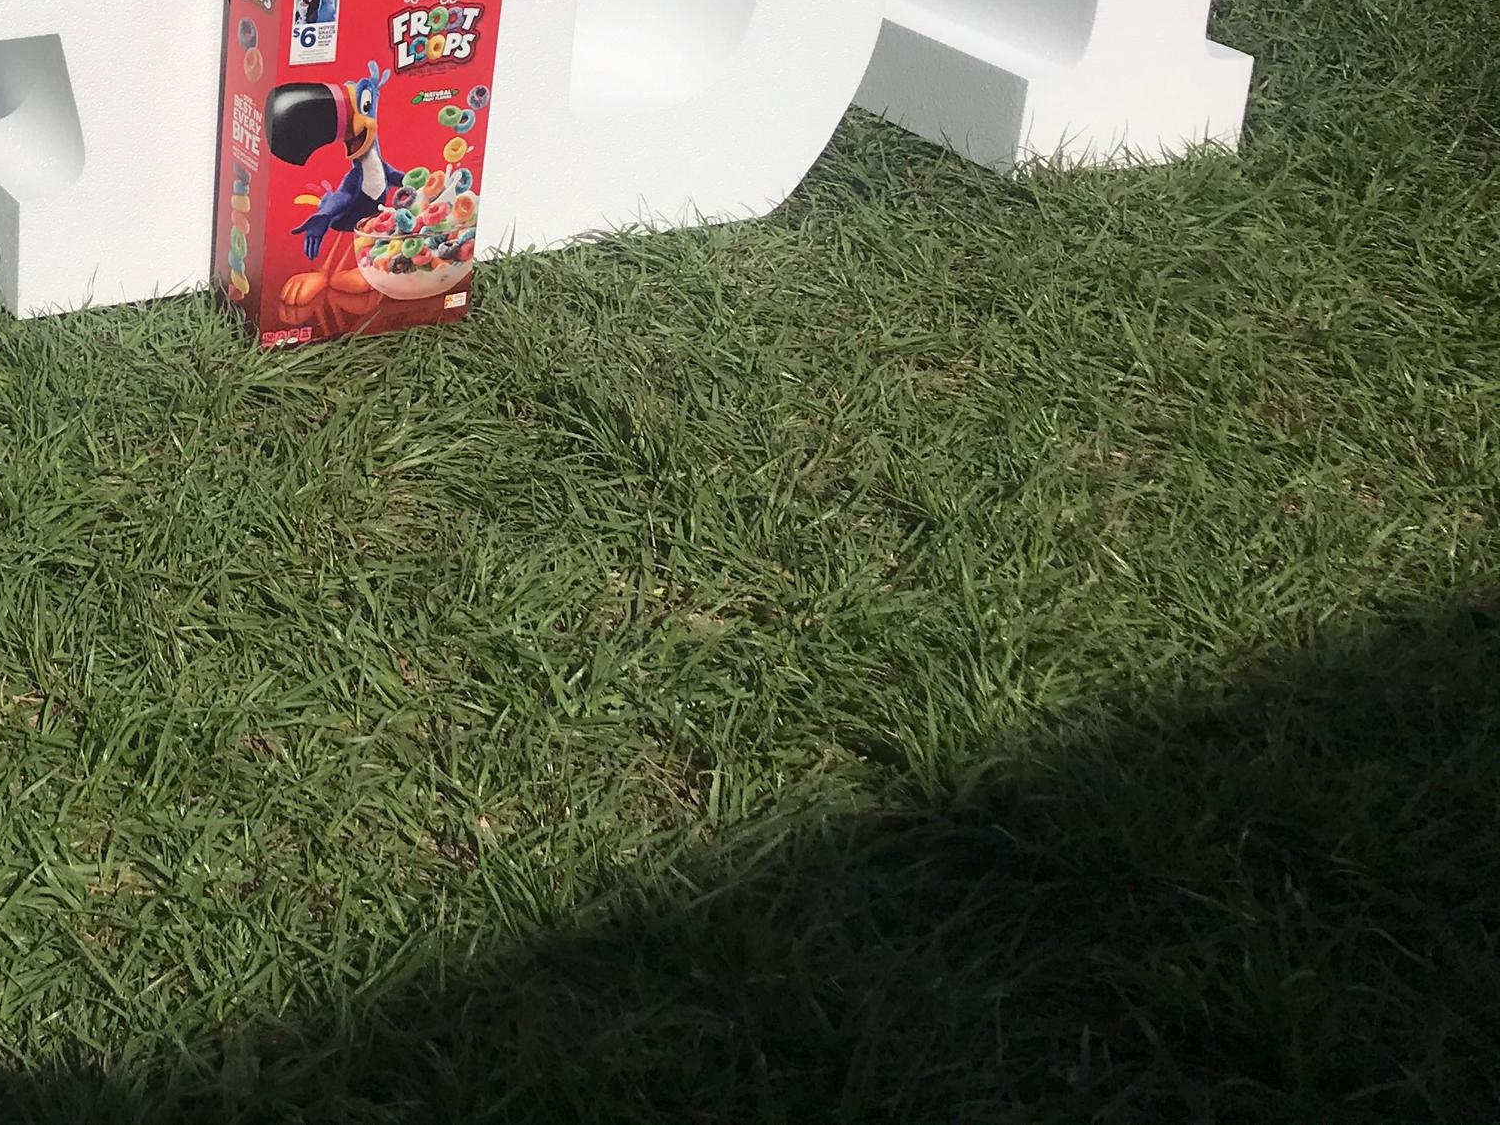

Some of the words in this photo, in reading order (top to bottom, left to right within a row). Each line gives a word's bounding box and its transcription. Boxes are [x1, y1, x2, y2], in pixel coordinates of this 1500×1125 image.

[392, 6, 480, 44] FROOT
[398, 32, 476, 69] LOOPS
[233, 106, 262, 136] EVERY
[234, 94, 253, 117] BEST
[253, 108, 263, 123] IN
[233, 119, 260, 156] BITE
